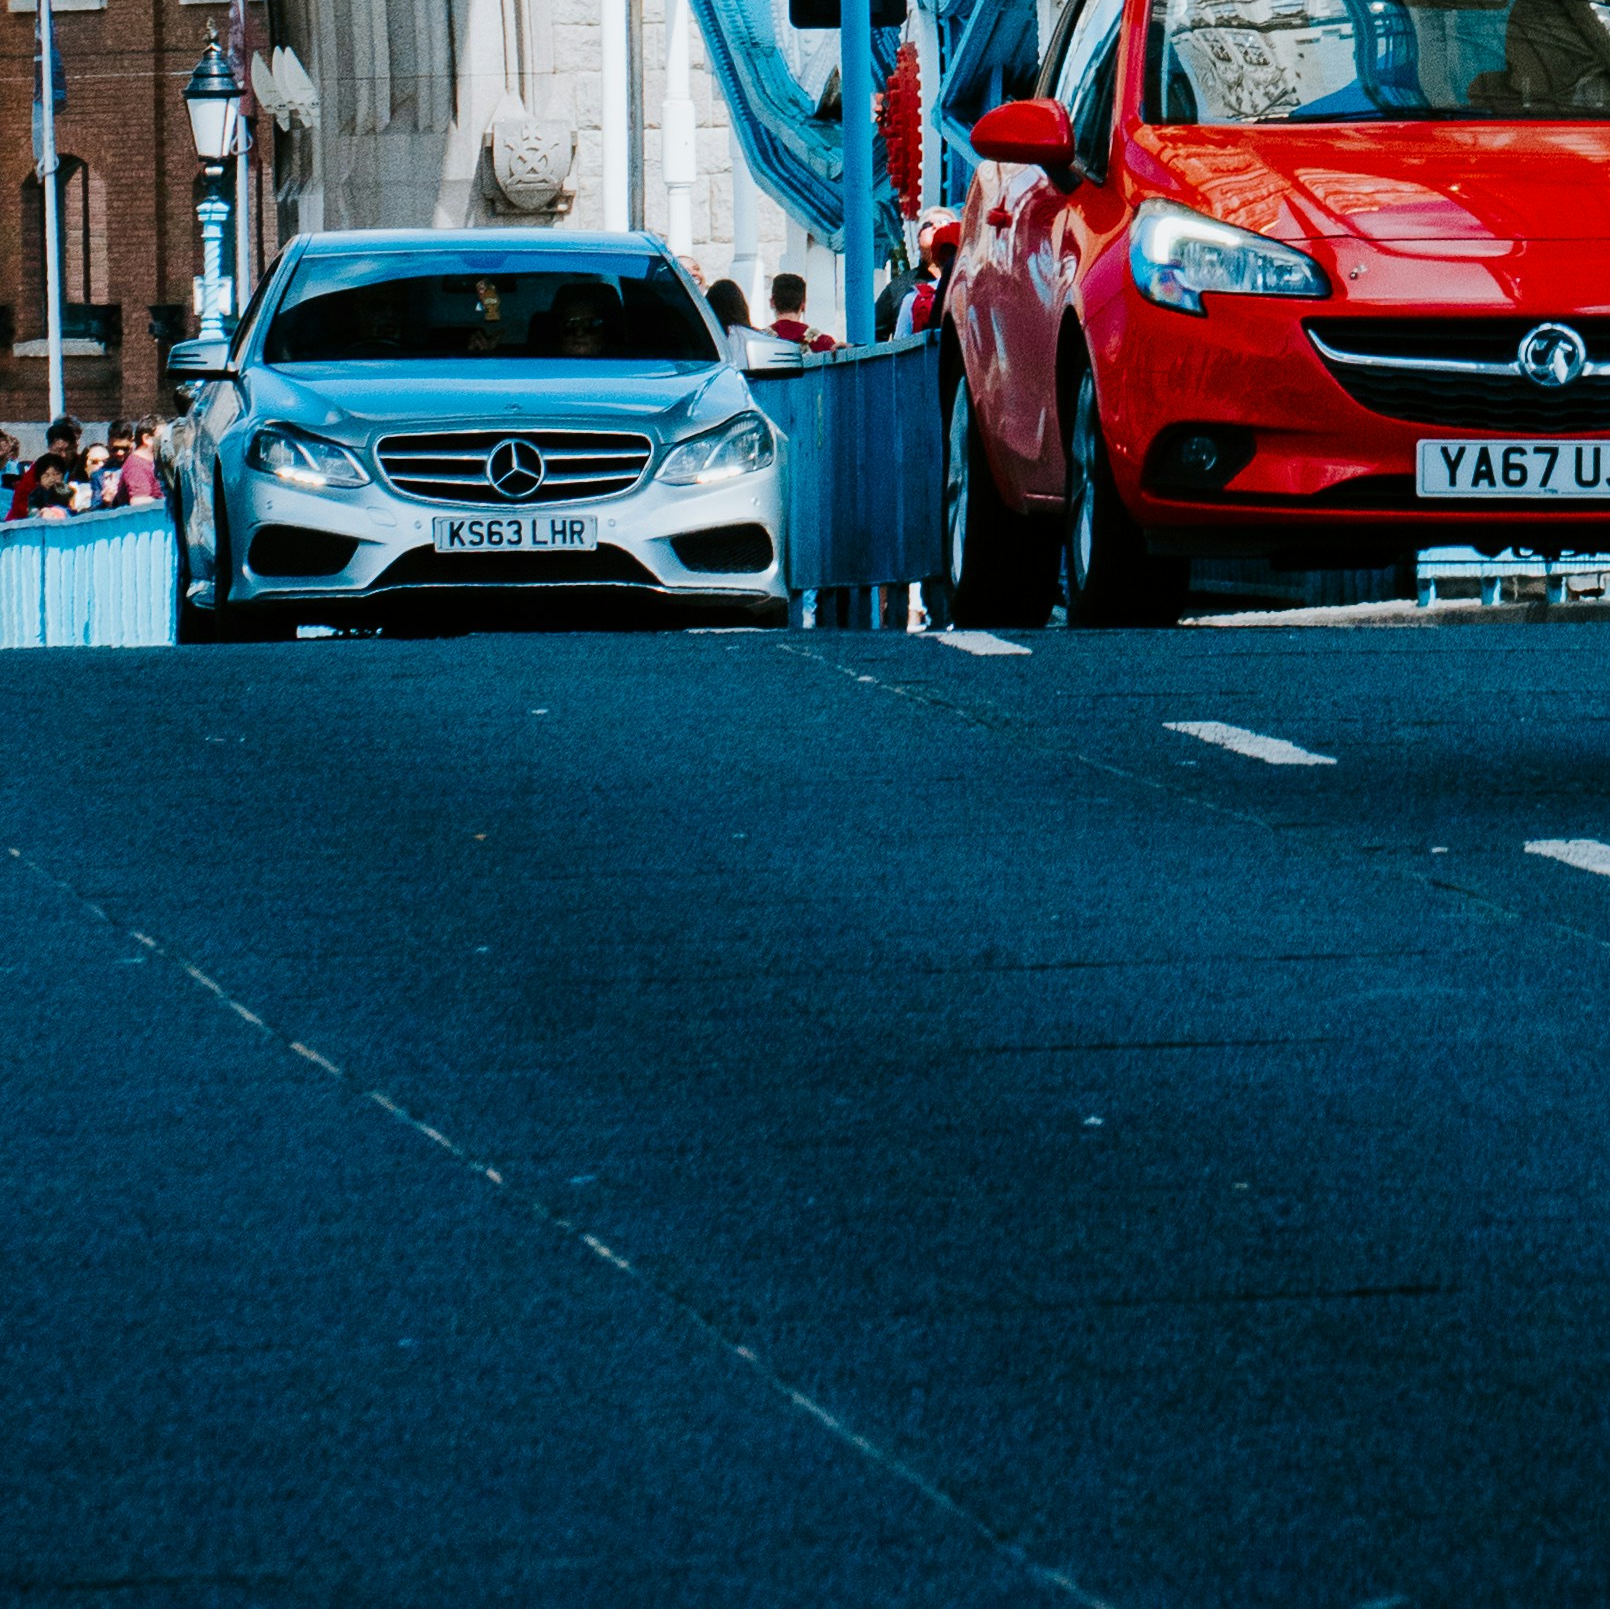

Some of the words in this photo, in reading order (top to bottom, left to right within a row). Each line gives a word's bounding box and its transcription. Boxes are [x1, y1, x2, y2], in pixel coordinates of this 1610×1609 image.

[1439, 445, 1560, 489] YA67
[449, 519, 523, 547] KS63
[531, 518, 586, 546] LHR
